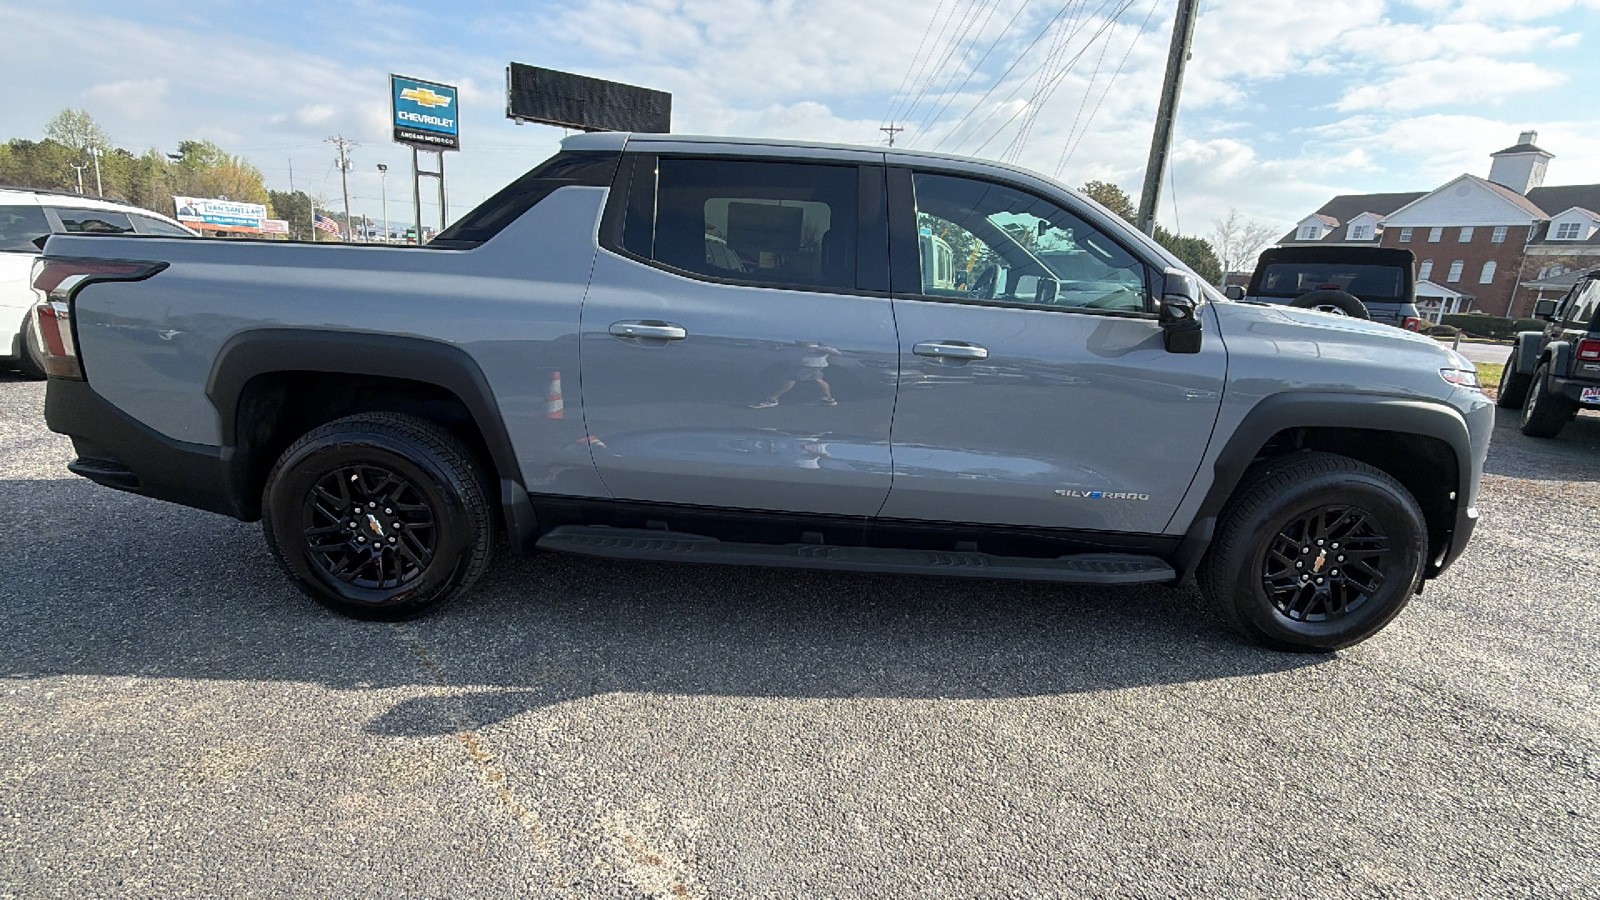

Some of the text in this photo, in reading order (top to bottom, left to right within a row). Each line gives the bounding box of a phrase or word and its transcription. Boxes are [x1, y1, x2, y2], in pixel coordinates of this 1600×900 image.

[398, 111, 454, 127] CHEVROLET
[425, 135, 445, 143] MOTOR
[1055, 489, 1150, 501] SILVERADO
